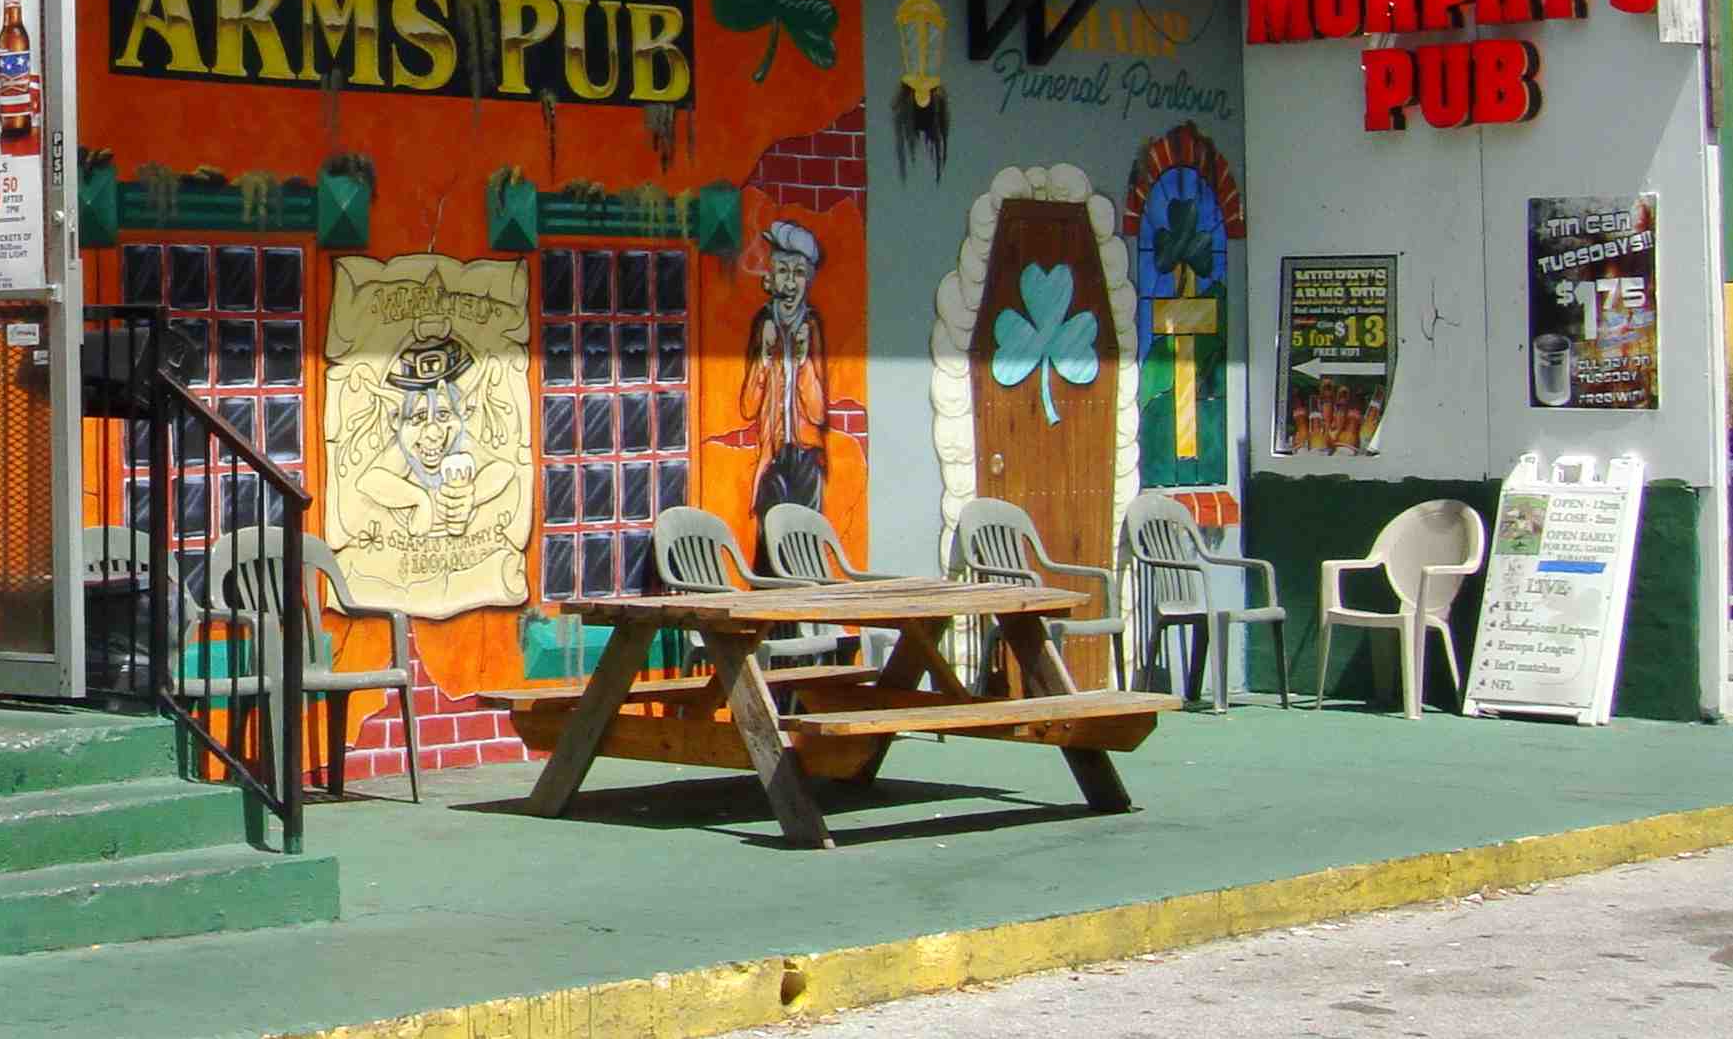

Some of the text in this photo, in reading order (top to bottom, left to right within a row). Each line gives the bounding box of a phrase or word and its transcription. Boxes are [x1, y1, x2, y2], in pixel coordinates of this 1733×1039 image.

[992, 48, 1111, 114] Funeral
[1361, 39, 1540, 132] PUB
[1292, 330, 1304, 347] 5
[1489, 679, 1516, 691] NFL
